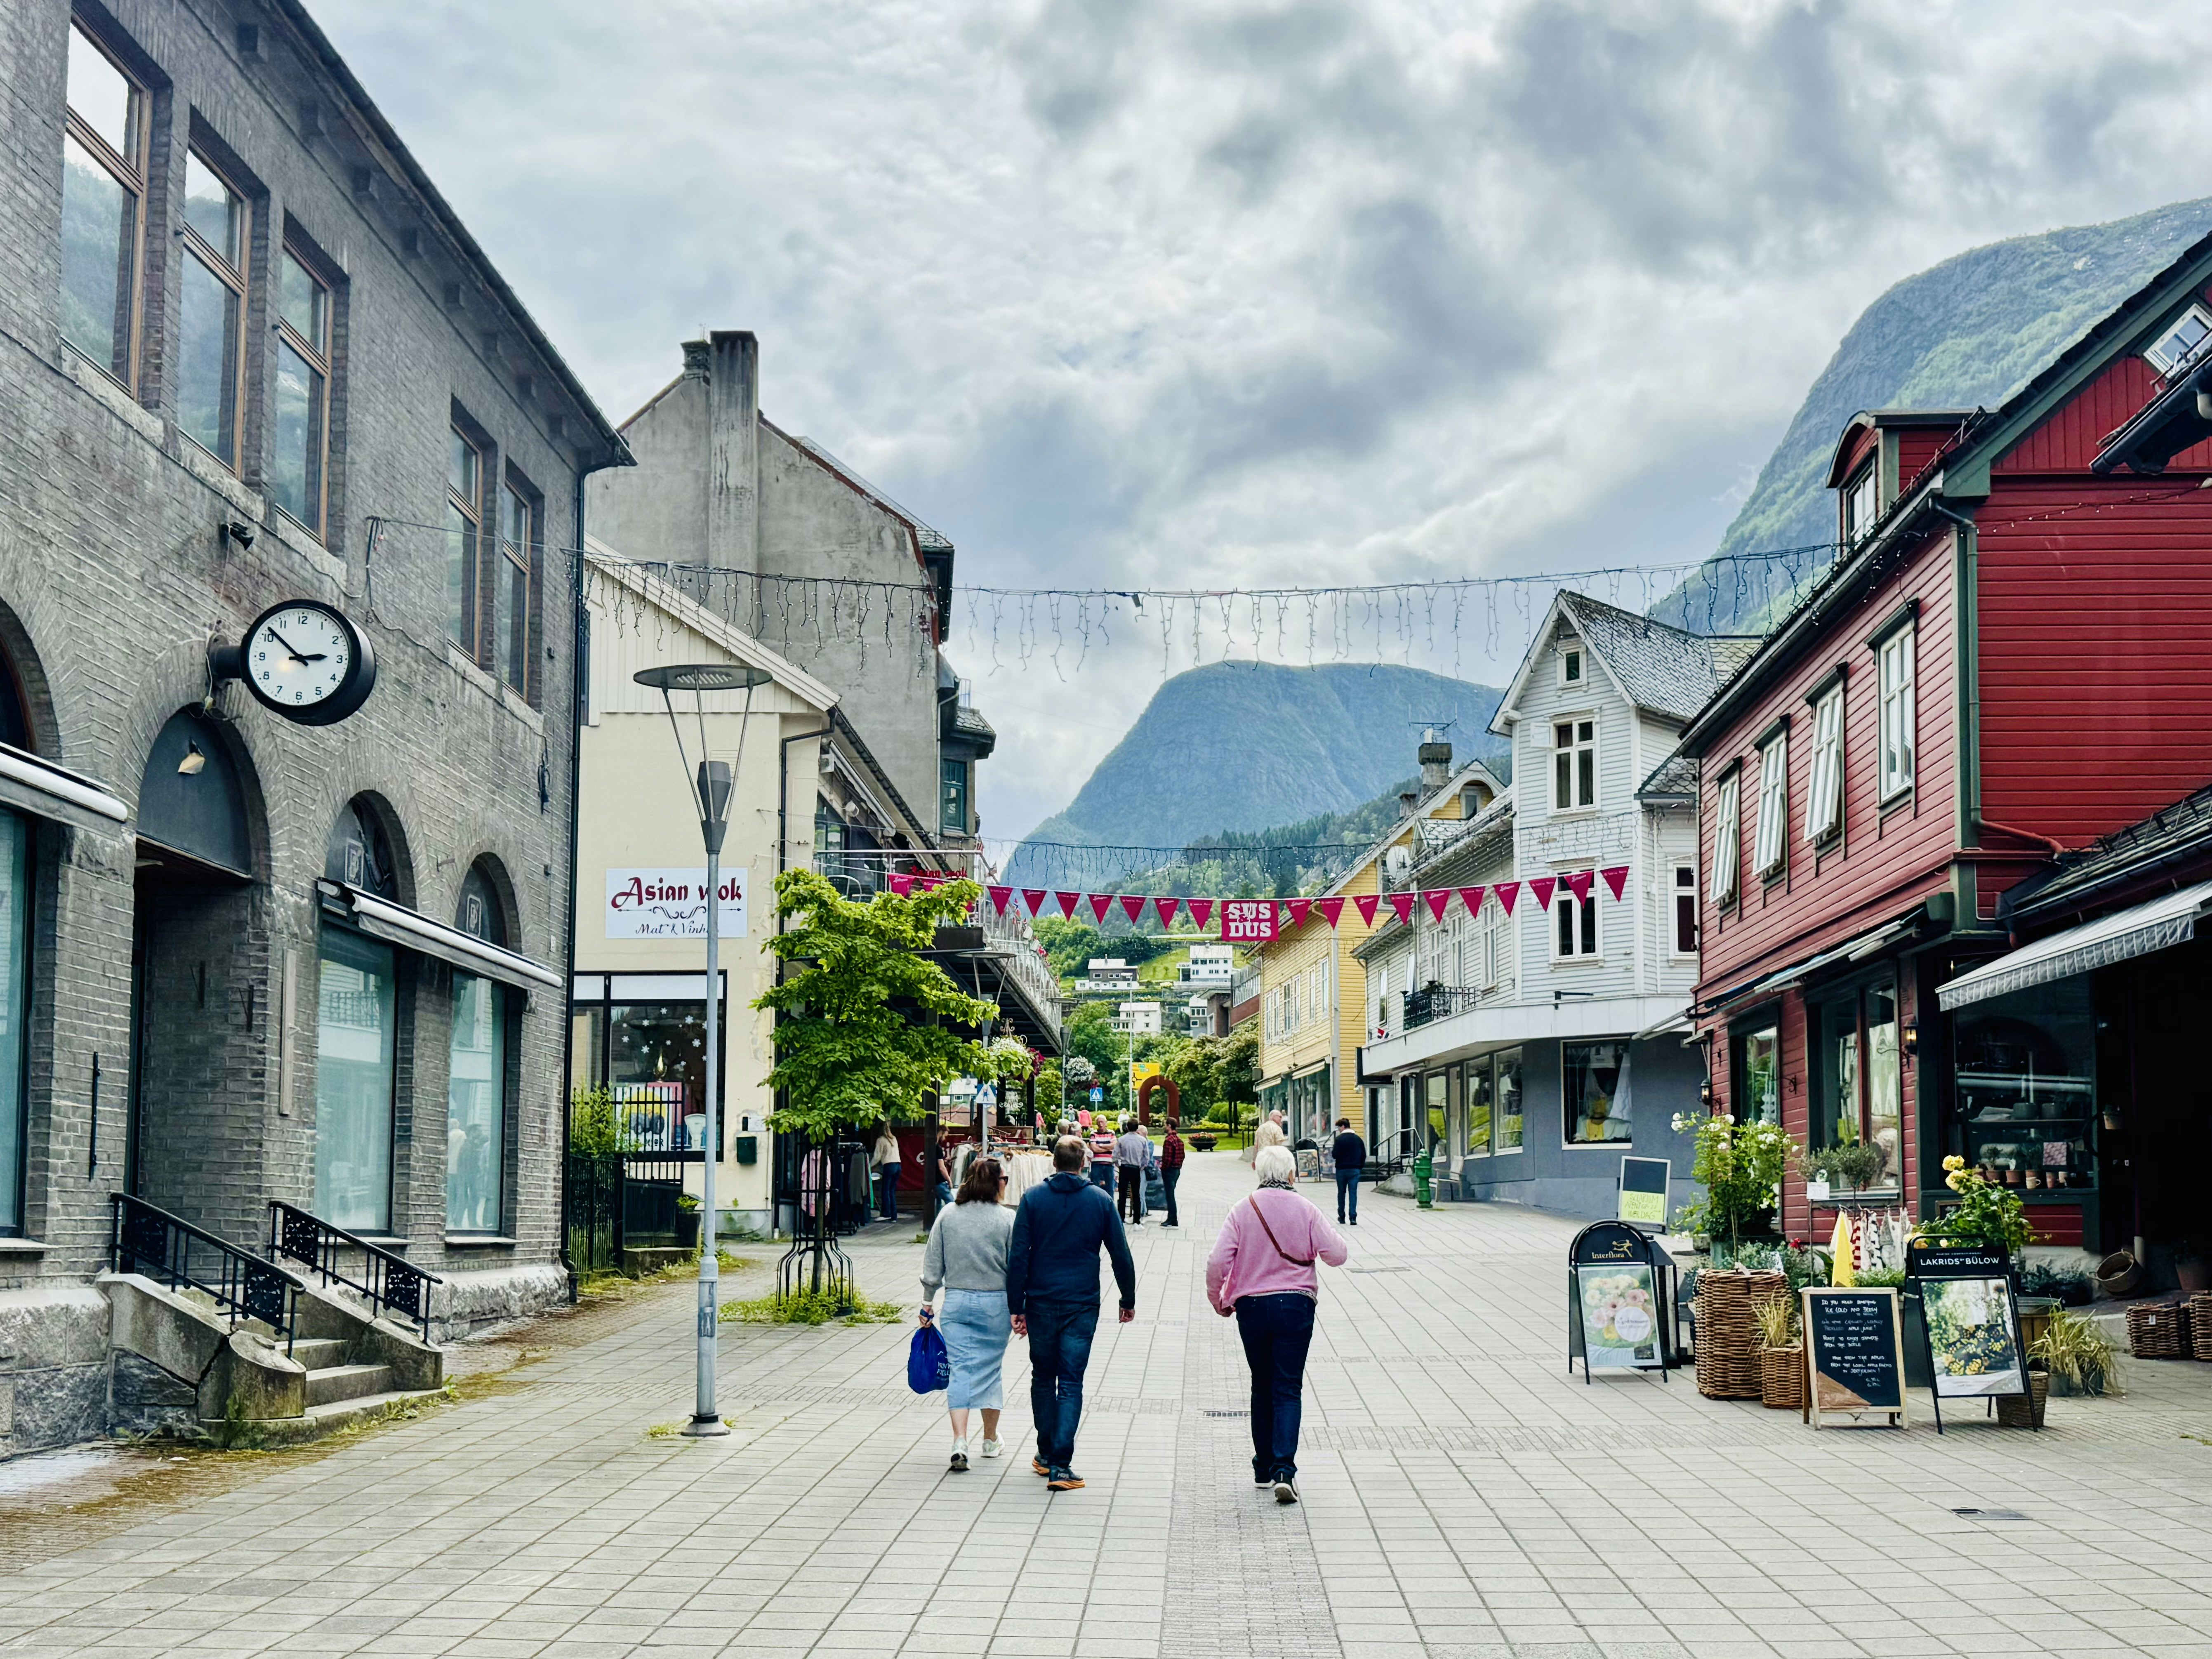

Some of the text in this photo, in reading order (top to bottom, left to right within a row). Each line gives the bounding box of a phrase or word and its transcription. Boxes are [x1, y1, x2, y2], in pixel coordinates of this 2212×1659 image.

[298, 615, 308, 624] 12
[280, 620, 286, 629] 11
[320, 621, 323, 630] 1
[264, 633, 274, 643] 10
[332, 636, 339, 644] 2
[259, 652, 266, 661] 9
[336, 655, 343, 663] 3
[263, 672, 269, 680] 8
[330, 674, 336, 682] 4
[277, 686, 283, 694] 7
[315, 687, 322, 695] 5
[296, 691, 302, 700] 6
[611, 877, 688, 909] Asian
[1227, 902, 1271, 919] SUS
[635, 923, 669, 934] Mat
[671, 922, 678, 935] &
[1229, 921, 1272, 937] DUS
[1640, 1211, 1655, 1220] DAG
[1592, 1251, 1625, 1259] Interflora
[1965, 1256, 1999, 1265] BÜLOW
